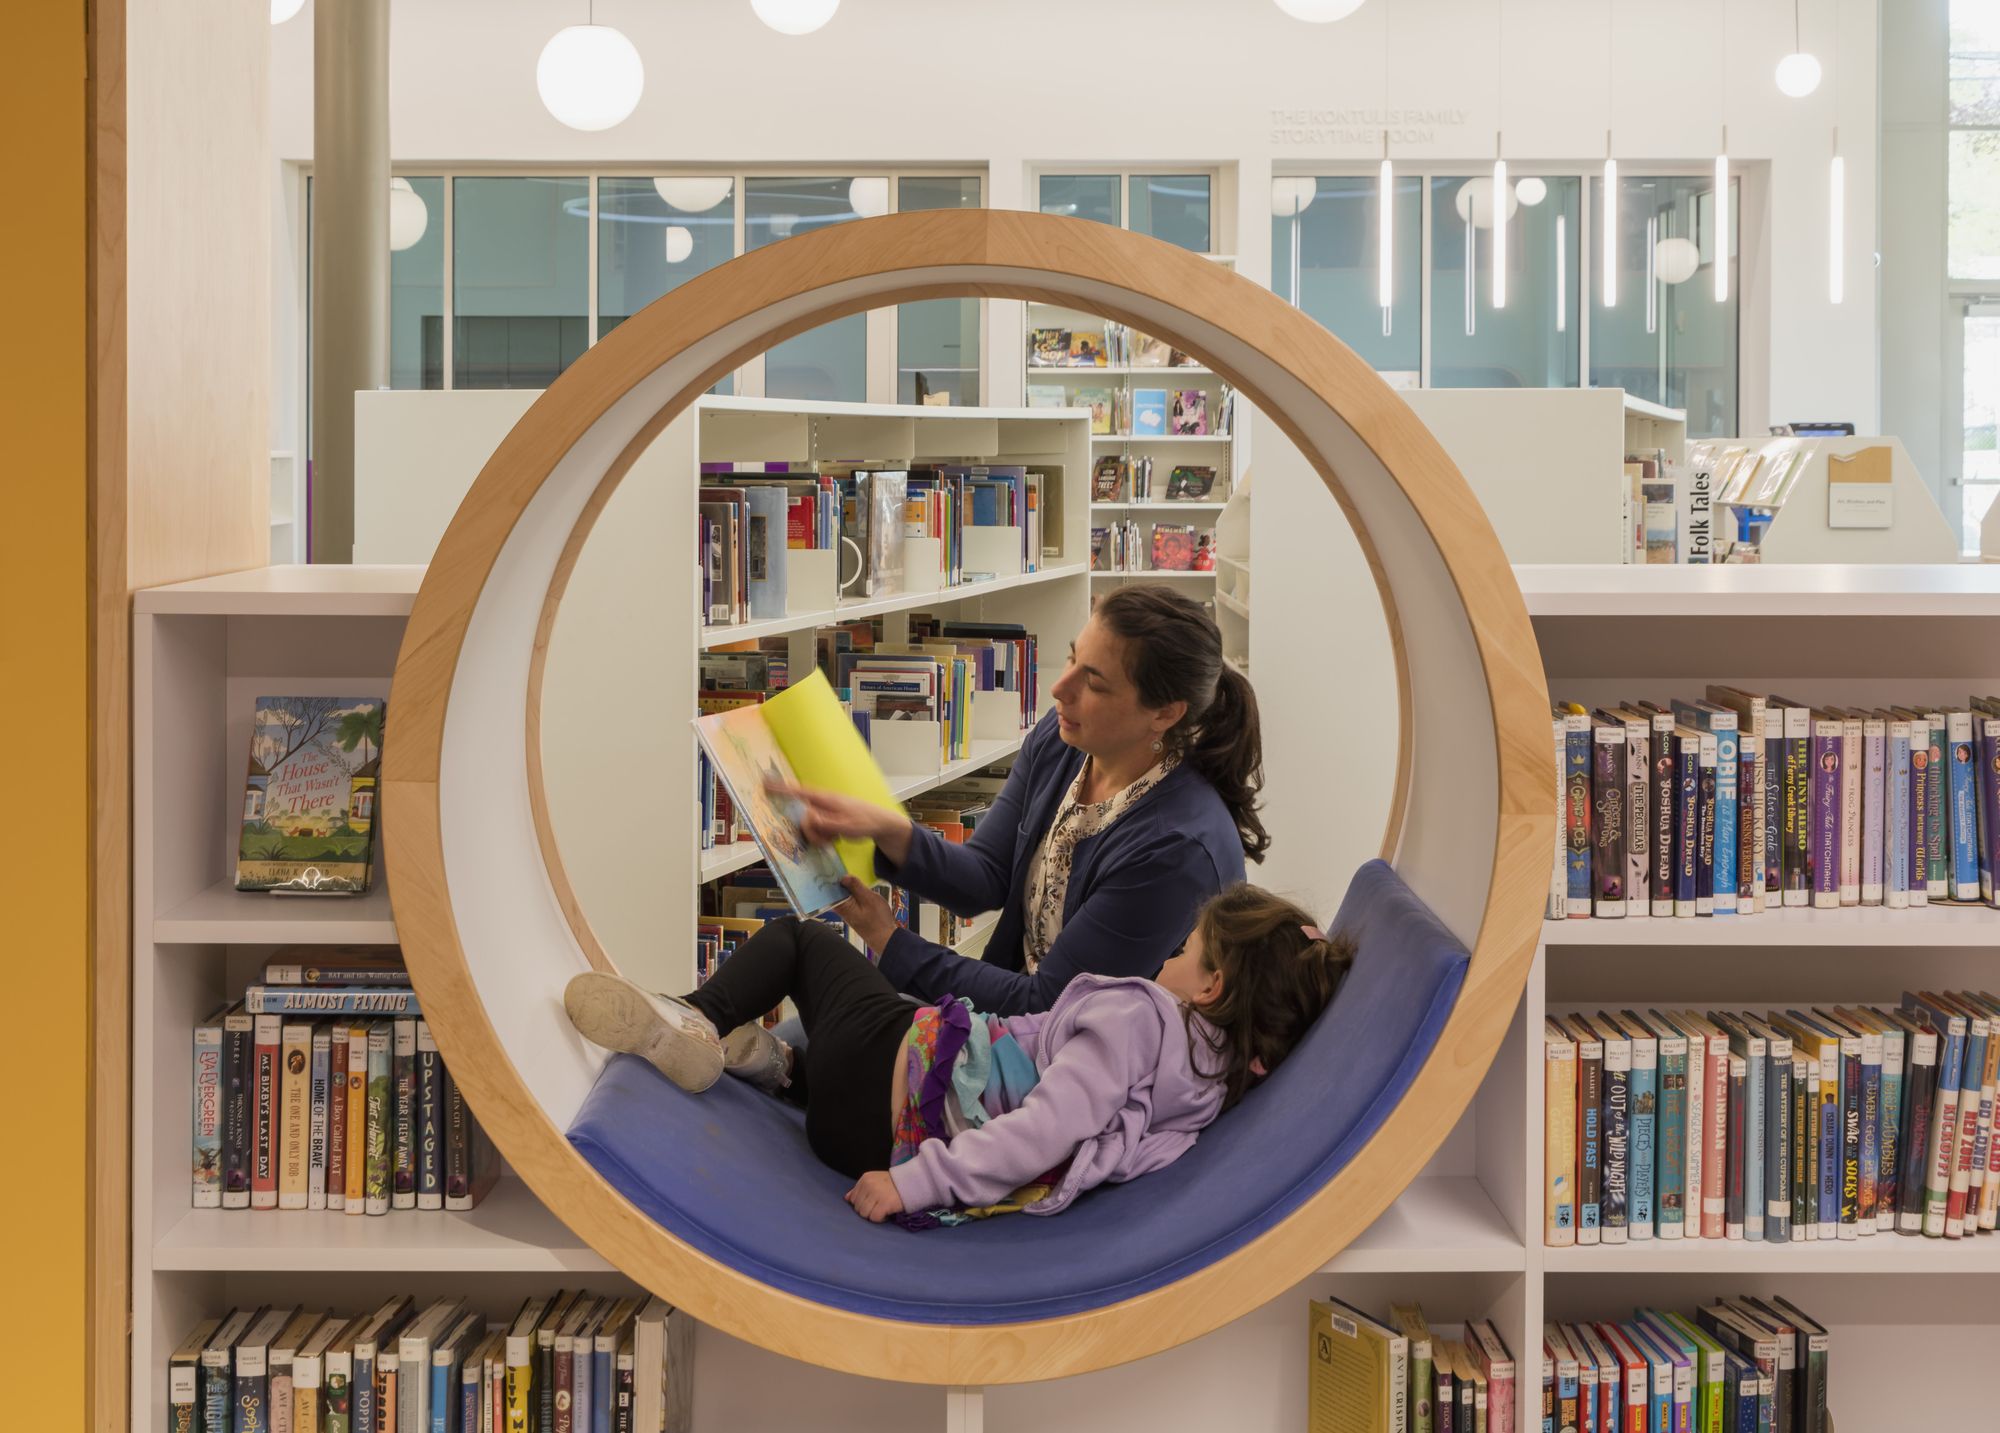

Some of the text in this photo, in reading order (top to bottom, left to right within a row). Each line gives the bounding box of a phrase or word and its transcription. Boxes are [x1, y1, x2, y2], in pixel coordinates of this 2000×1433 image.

[1689, 472, 1710, 555] Folk Tales
[281, 761, 330, 782] House
[301, 751, 319, 764] The
[1754, 753, 1764, 784] MISS
[276, 775, 340, 797] That Wasn't
[288, 793, 335, 814] There
[1716, 740, 1736, 888] OBIE is Man Enough
[1766, 782, 1779, 820] Silver
[1785, 755, 1796, 833] of Ferny Creek Library
[1799, 772, 1807, 805] TINY
[1928, 766, 1941, 860] Unlocking the Spell
[1635, 785, 1644, 850] THE PECULIAR
[1660, 779, 1671, 880] JOSHUA DREAD
[1685, 795, 1695, 876] JOSHUA DREAD
[1704, 798, 1714, 865] JOSHUA DREAD
[1742, 809, 1752, 882] CHASING VERMEER
[1766, 826, 1777, 851] Gale
[1798, 810, 1807, 850] HERO
[1915, 772, 1927, 880] Princess between Worlds
[283, 993, 409, 1011] ALMOST FLYING
[200, 1051, 219, 1137] EVA EVERGREEN
[399, 1078, 409, 1092] THE
[1717, 1056, 1727, 1080] KEY
[259, 1055, 269, 1178] MS. BIXBY'S LAST DAY
[289, 1087, 301, 1177] THE ONE AND ONLY BOB
[312, 1079, 325, 1168] HOME OF THE BRAVE
[333, 1104, 342, 1121] Boy
[368, 1095, 381, 1161] Just Harriet
[398, 1123, 408, 1143] FLEW
[399, 1095, 408, 1115] YEAR
[423, 1052, 436, 1189] UPSTAGED
[1715, 1099, 1726, 1150] INDIAN
[1847, 1111, 1860, 1143] SWAG
[1881, 1081, 1897, 1176] RISE JUMBIES
[333, 1125, 342, 1152] Called
[398, 1145, 408, 1169] AWAY
[1586, 1108, 1597, 1169] HOLD FAST
[1609, 1085, 1626, 1194] OUT of the WILD NIGHT
[1635, 1118, 1651, 1150] PIECES
[1690, 1102, 1700, 1185] SEAGLASS SUMMER
[1781, 1129, 1786, 1140] OF
[1825, 1112, 1834, 1195] ISAIAH DUNN HERO
[1864, 1081, 1877, 1205] JUMBIE GOD'S REVENGE
[1937, 1104, 1955, 1178] KICKOFF!
[1958, 1111, 1977, 1172] RED ZONE
[1971, 1100, 1992, 1170] GO LONG!
[1990, 1133, 2000, 1172] CARD
[332, 1155, 341, 1176] BAT
[1634, 1164, 1651, 1197] PLAYERS
[1844, 1160, 1858, 1198] SOCKS
[358, 1390, 370, 1433] POPPY
[1395, 1355, 1404, 1433] AVI CRISPIN
